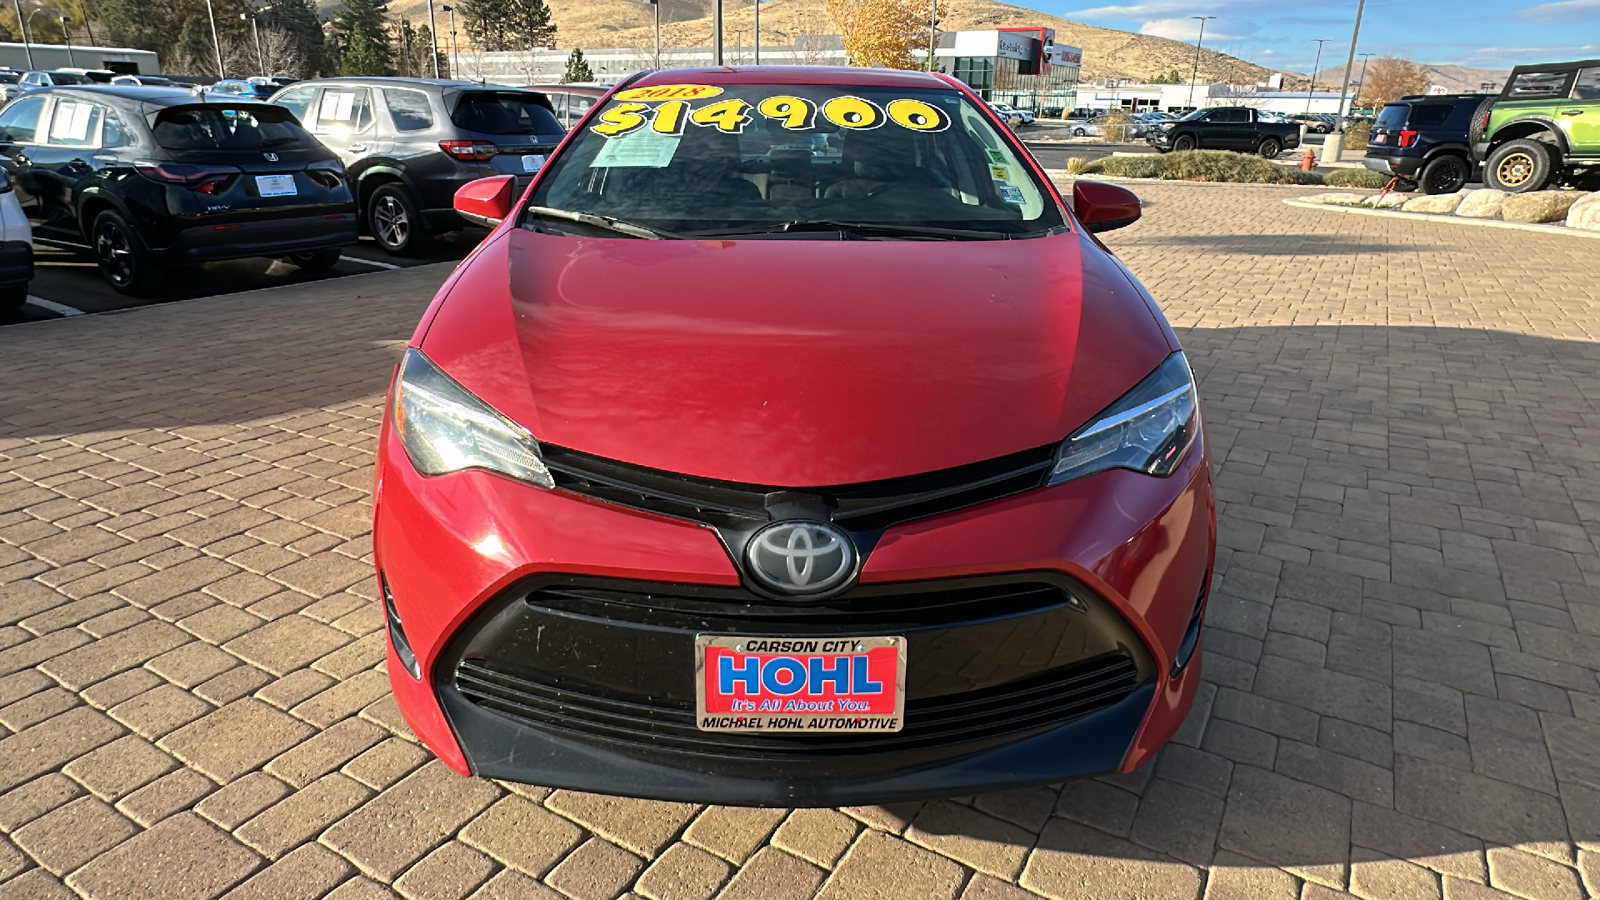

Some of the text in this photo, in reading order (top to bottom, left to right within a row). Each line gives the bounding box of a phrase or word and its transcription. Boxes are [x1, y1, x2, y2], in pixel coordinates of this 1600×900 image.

[629, 86, 706, 99] 2018
[590, 95, 952, 138] $14900
[746, 640, 861, 653] CARSON CITY
[718, 655, 883, 696] HOHL
[731, 698, 871, 711] It's All About You.
[702, 716, 898, 729] MICHAEL HOHL AUTOMOTIVE
